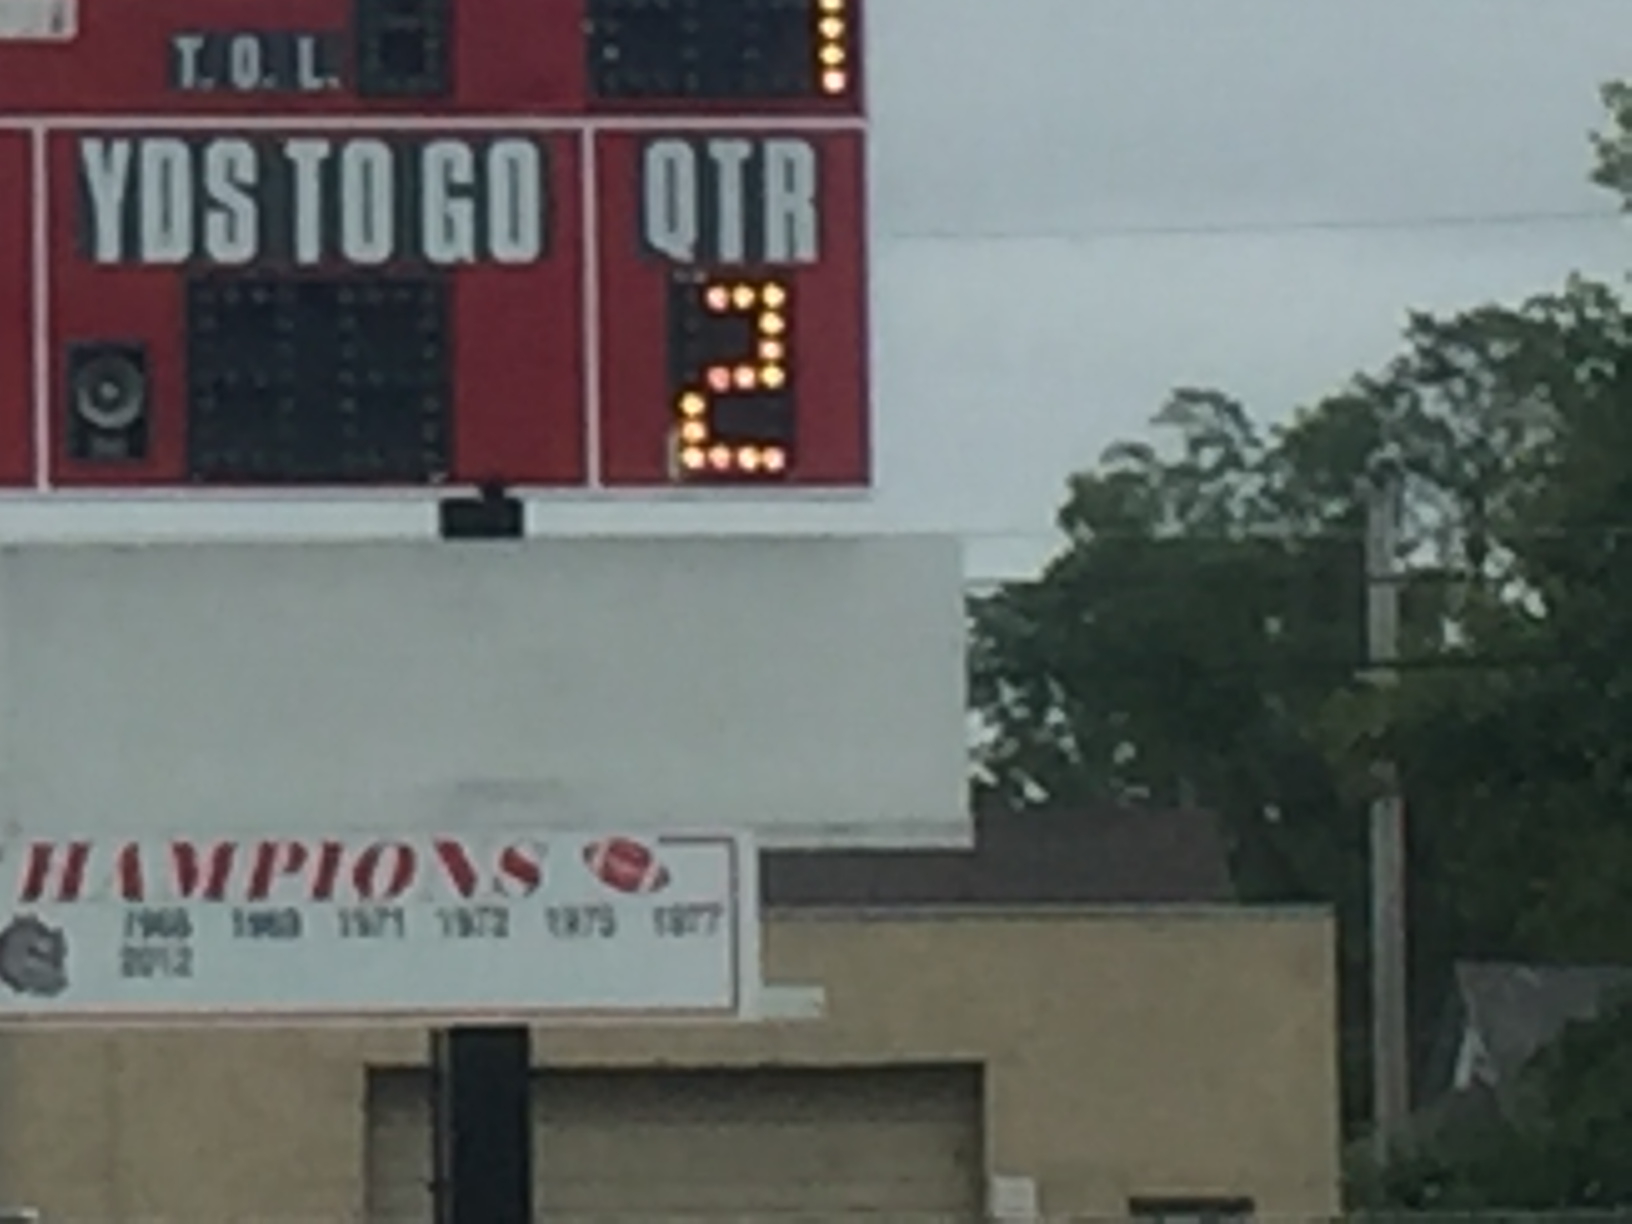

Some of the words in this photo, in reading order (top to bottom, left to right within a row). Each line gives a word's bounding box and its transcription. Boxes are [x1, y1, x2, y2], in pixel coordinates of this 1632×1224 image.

[80, 138, 259, 265] YDS
[284, 138, 394, 265] TO
[421, 138, 545, 265] GO
[643, 138, 819, 265] QTR
[678, 283, 787, 472] 2
